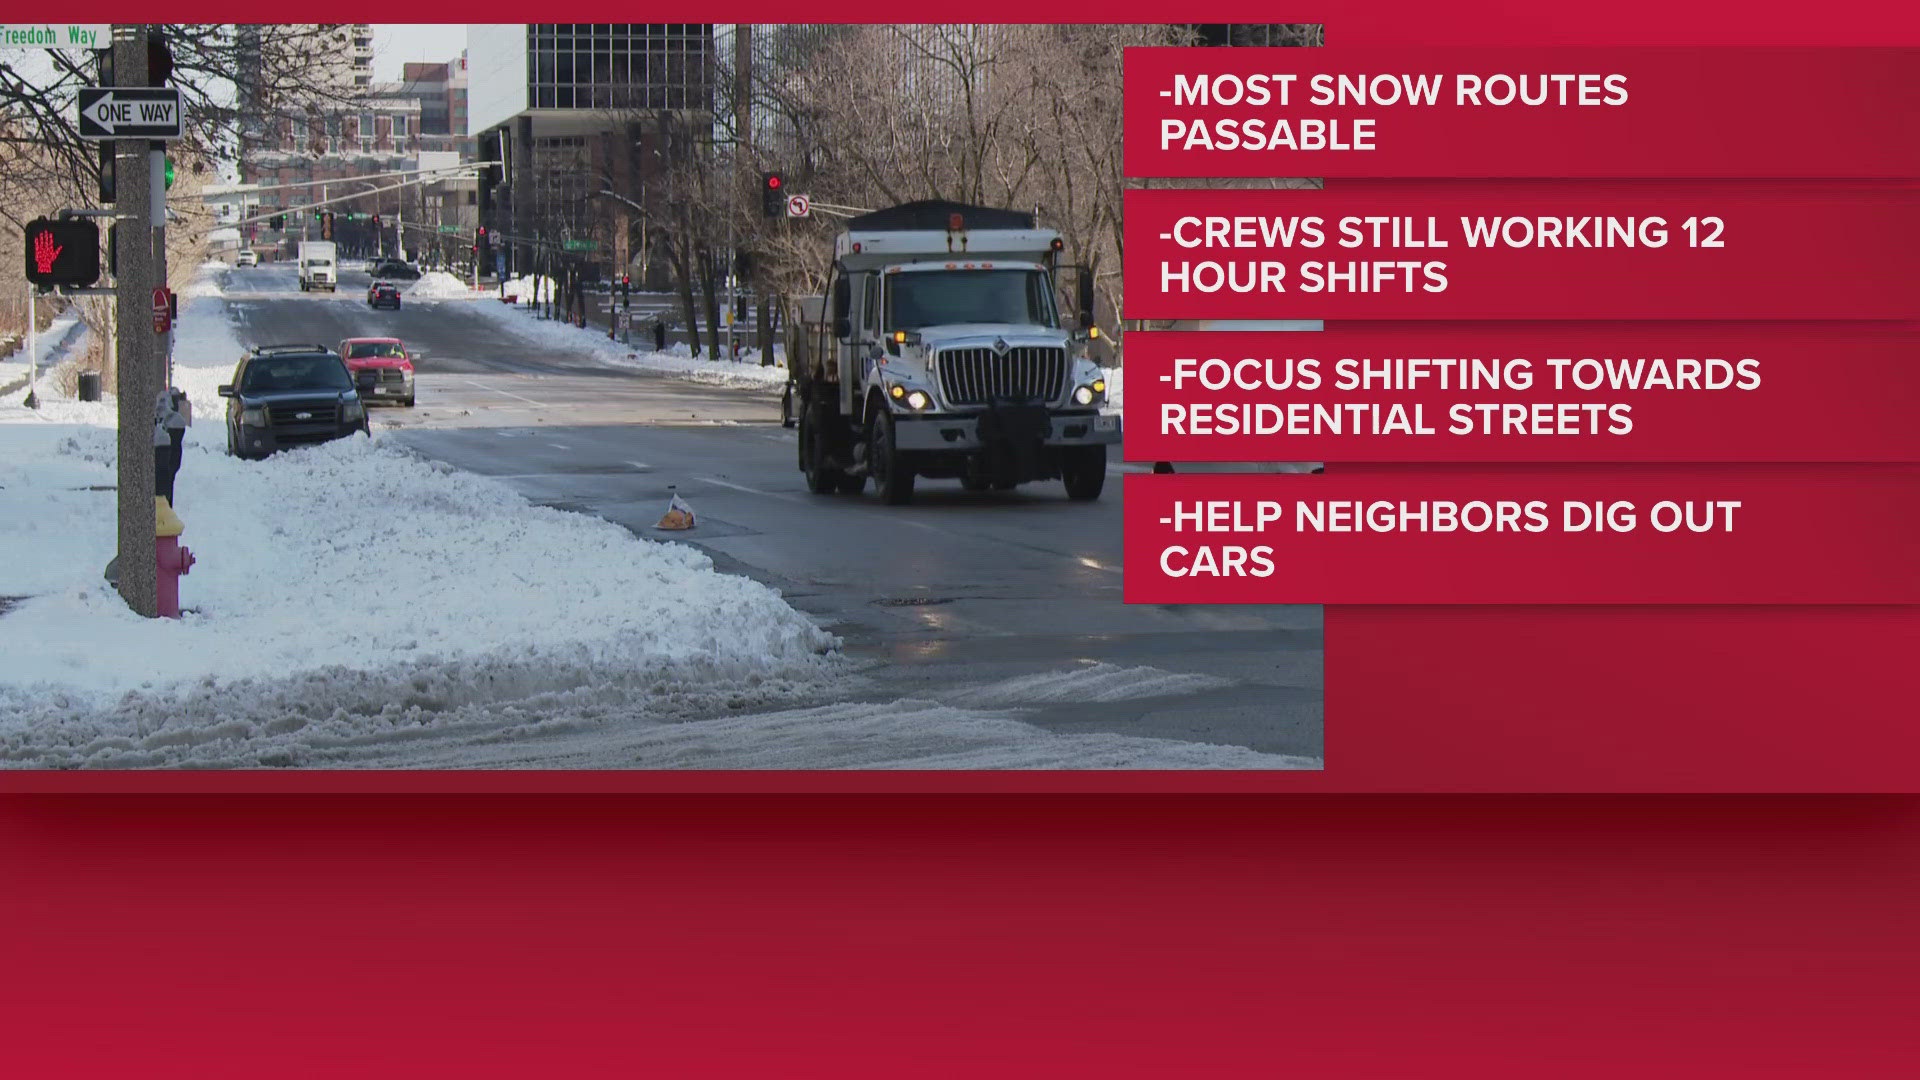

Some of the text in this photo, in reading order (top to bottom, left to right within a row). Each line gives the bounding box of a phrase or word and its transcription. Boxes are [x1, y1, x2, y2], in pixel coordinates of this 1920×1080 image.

[69, 26, 97, 48] Way
[97, 104, 172, 122] ONE WAY
